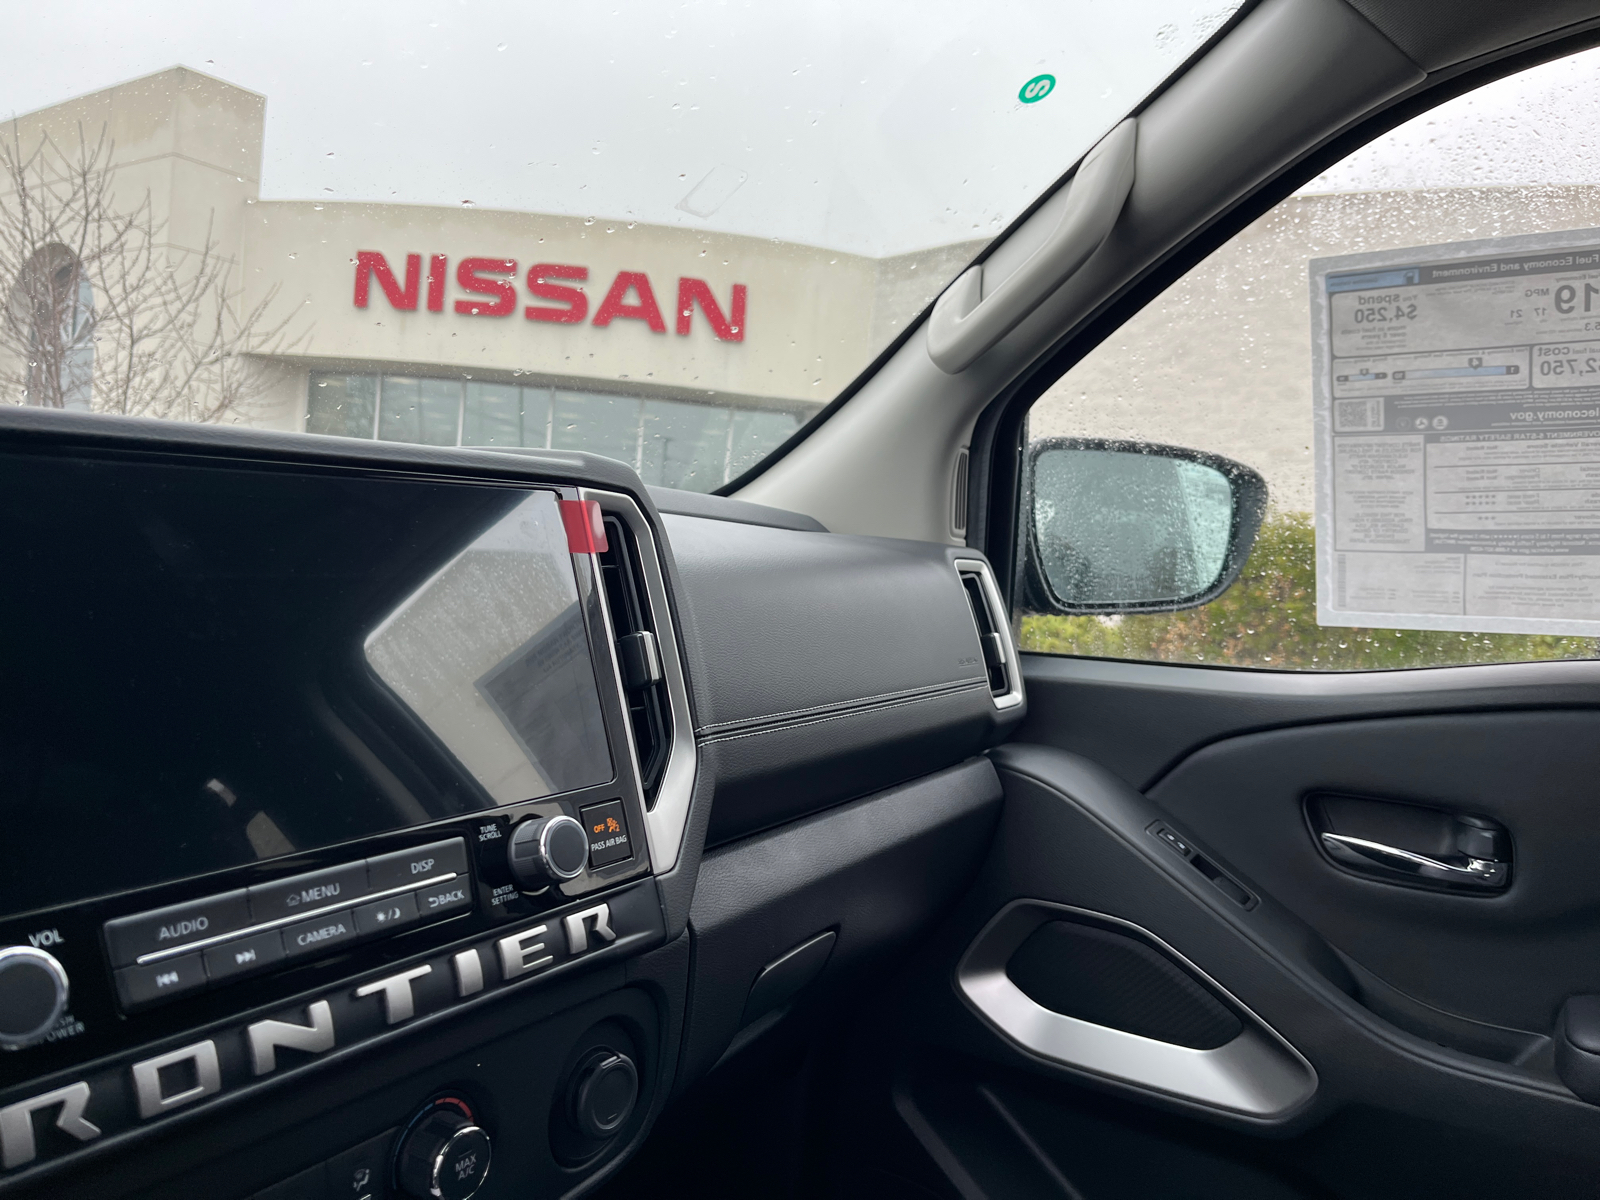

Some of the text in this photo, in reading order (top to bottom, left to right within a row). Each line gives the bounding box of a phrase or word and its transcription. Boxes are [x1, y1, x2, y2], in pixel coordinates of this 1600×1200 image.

[353, 250, 748, 342] NISSAN
[479, 831, 502, 842] SCROLL
[480, 823, 497, 833] TUNE
[593, 823, 605, 833] OFF
[591, 835, 627, 851] PASS AIR BAG
[410, 858, 435, 875] DISP
[301, 883, 341, 903] MENU
[438, 889, 465, 906] BACK
[491, 891, 519, 906] SETTING
[493, 884, 514, 896] ENTER
[158, 917, 209, 941] AUDIO
[297, 924, 347, 946] CAMERA
[28, 928, 65, 948] VOL
[455, 1153, 477, 1172] MAX
[458, 1164, 476, 1181] A/C
